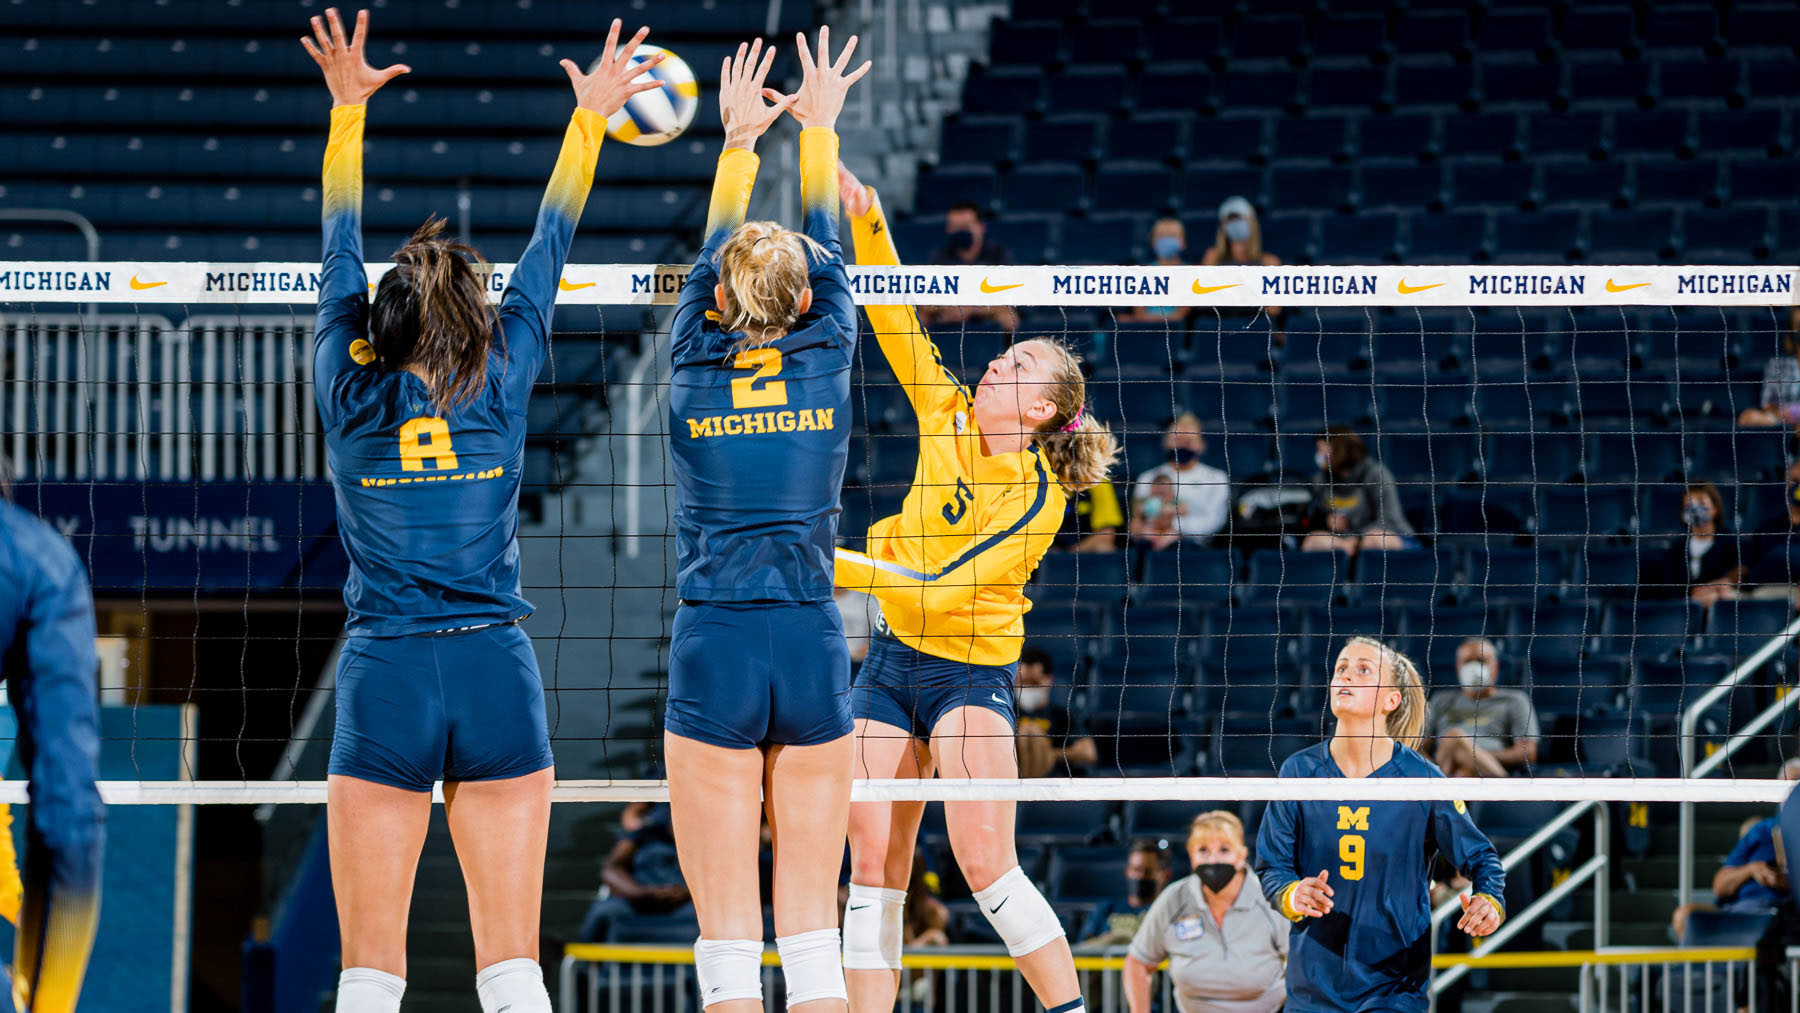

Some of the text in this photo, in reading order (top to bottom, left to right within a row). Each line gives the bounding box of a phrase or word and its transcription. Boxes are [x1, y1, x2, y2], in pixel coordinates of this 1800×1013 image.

[205, 272, 323, 292] MICHIGAN
[631, 274, 690, 293] MICH
[1052, 275, 1170, 295] MICHIGAN
[1261, 275, 1378, 295] MICHIGAN
[1469, 275, 1586, 295] MICHIGAN
[1677, 274, 1791, 294] MICHIGAN
[731, 347, 788, 409] 2
[686, 407, 835, 439] MICHIGAN
[399, 416, 459, 472] 8
[129, 515, 279, 552] TUNNEL
[1336, 806, 1371, 831] M
[1338, 834, 1366, 881] 9
